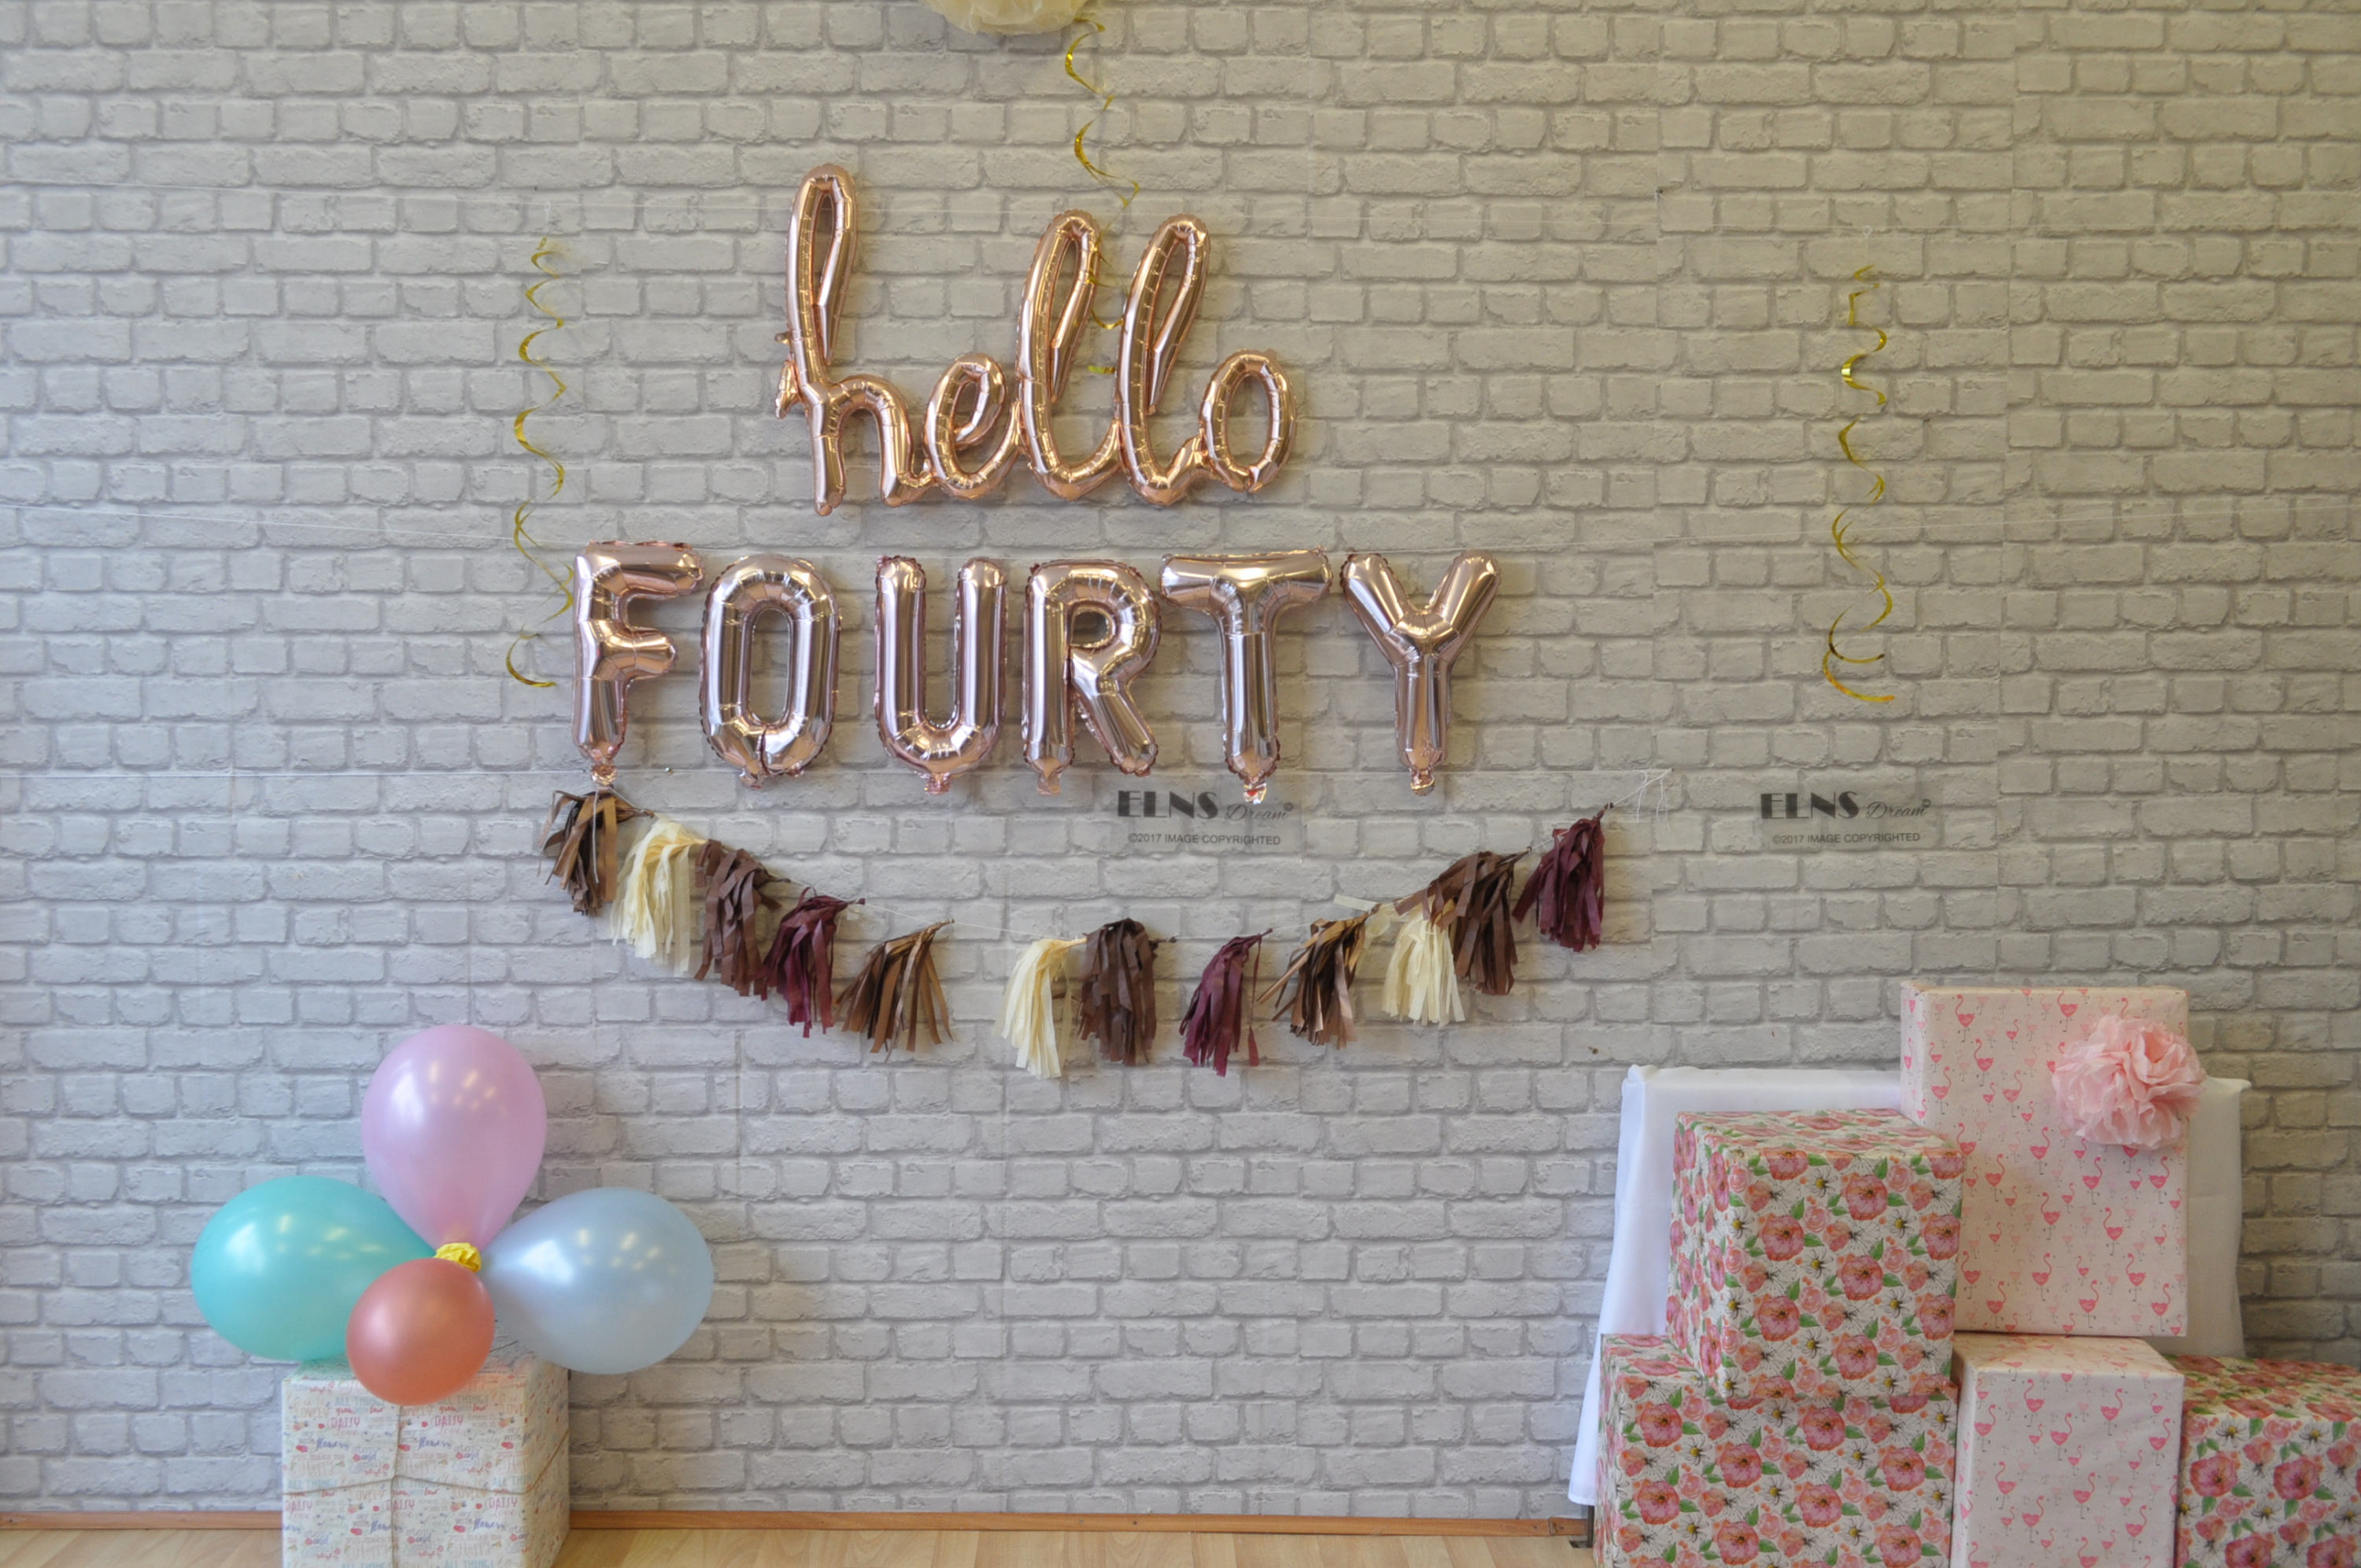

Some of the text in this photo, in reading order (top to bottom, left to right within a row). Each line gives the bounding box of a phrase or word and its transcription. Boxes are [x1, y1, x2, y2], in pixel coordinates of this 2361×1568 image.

[775, 163, 1299, 515] hello
[572, 540, 1502, 801] FOURTY
[1118, 790, 1218, 819] ELNS
[1761, 791, 1859, 820] ELNS
[1165, 834, 1199, 844] IMAGE
[1202, 834, 1281, 845] COPYRIGHTED
[1808, 834, 1841, 843] IMAGE
[1844, 832, 1920, 843] COPYRIGHTED
